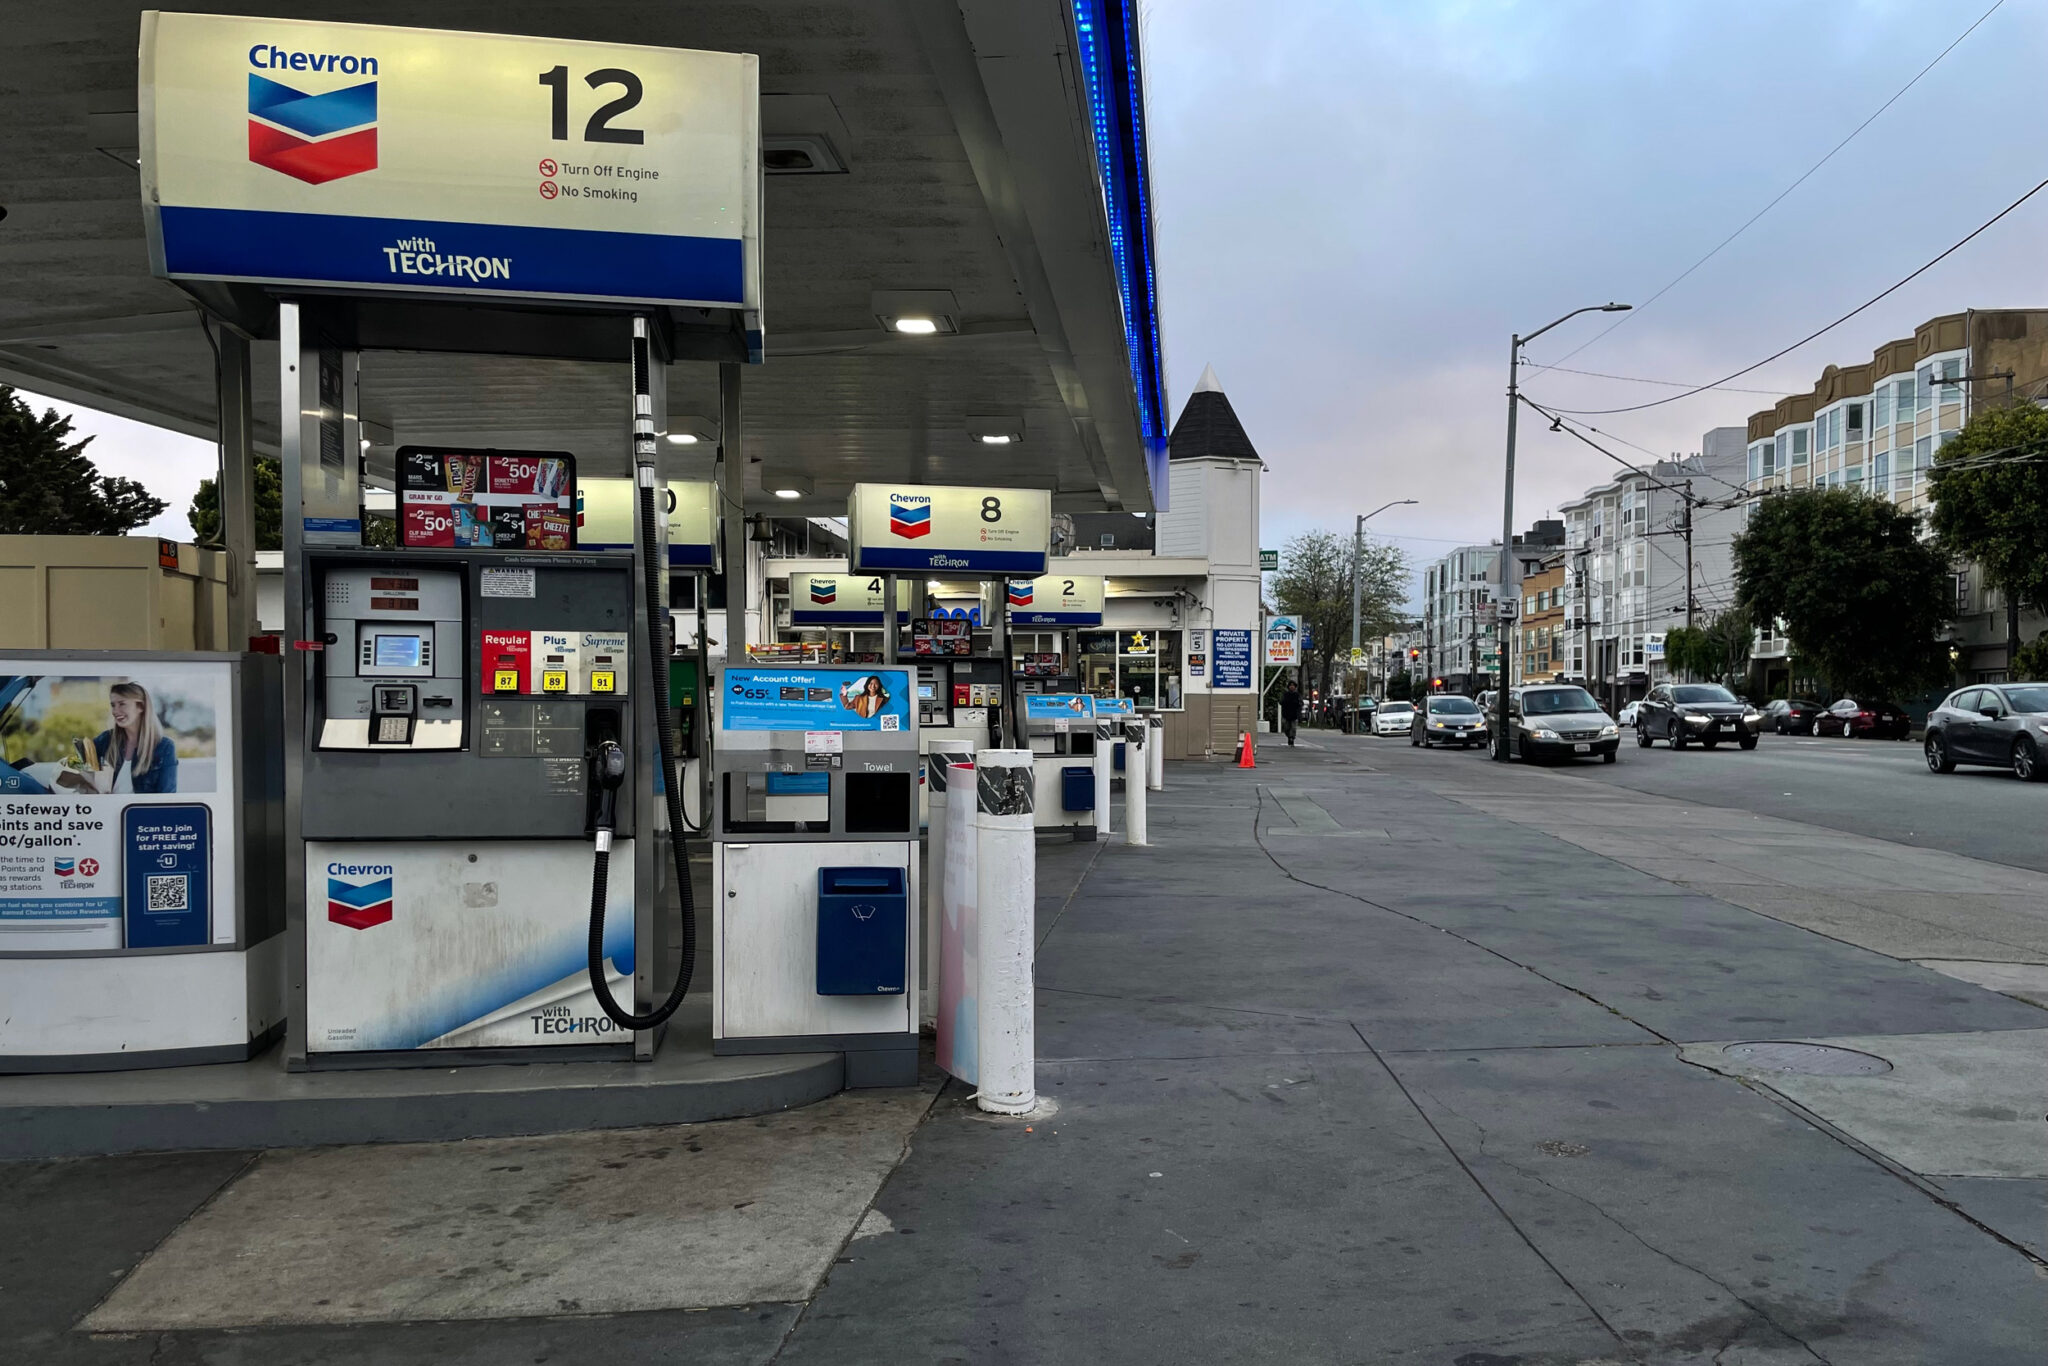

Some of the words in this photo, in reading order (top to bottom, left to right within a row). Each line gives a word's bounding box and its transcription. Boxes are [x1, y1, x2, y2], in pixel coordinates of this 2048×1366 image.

[249, 44, 378, 75] Chevron
[539, 65, 644, 145] 12
[562, 163, 589, 175] Turn
[594, 165, 612, 176] Off
[617, 167, 659, 180] Engine
[562, 186, 579, 197] No
[584, 187, 637, 203] Smoking
[397, 237, 436, 252] with
[383, 247, 510, 282] TECHRON
[416, 454, 423, 463] 2
[502, 457, 509, 466] 2
[424, 462, 438, 475] $1
[509, 464, 537, 478] 50¢
[890, 493, 931, 503] Chevron
[981, 496, 1002, 522] 8
[417, 510, 424, 519] 2
[503, 513, 510, 522] 2
[425, 517, 453, 530] 50¢
[511, 520, 525, 533] $1
[929, 558, 969, 568] TECHRON
[867, 578, 881, 593] 4
[1062, 580, 1075, 595] 2
[485, 635, 527, 645] Regular
[543, 636, 567, 645] Plus
[582, 634, 625, 648] Supreme
[1194, 641, 1201, 649] 5
[501, 677, 512, 685] 87
[597, 678, 607, 686] 91
[745, 689, 769, 699] 65¢
[765, 763, 793, 771] Trsh
[864, 762, 893, 771] Towel
[7, 803, 70, 816] Safeway
[76, 804, 92, 814] to
[34, 820, 62, 830] and
[68, 821, 103, 830] save
[175, 824, 192, 833] join
[162, 842, 195, 851] saving!
[327, 863, 393, 875] Chevron
[9, 883, 43, 891] stations.
[543, 1006, 570, 1016] with
